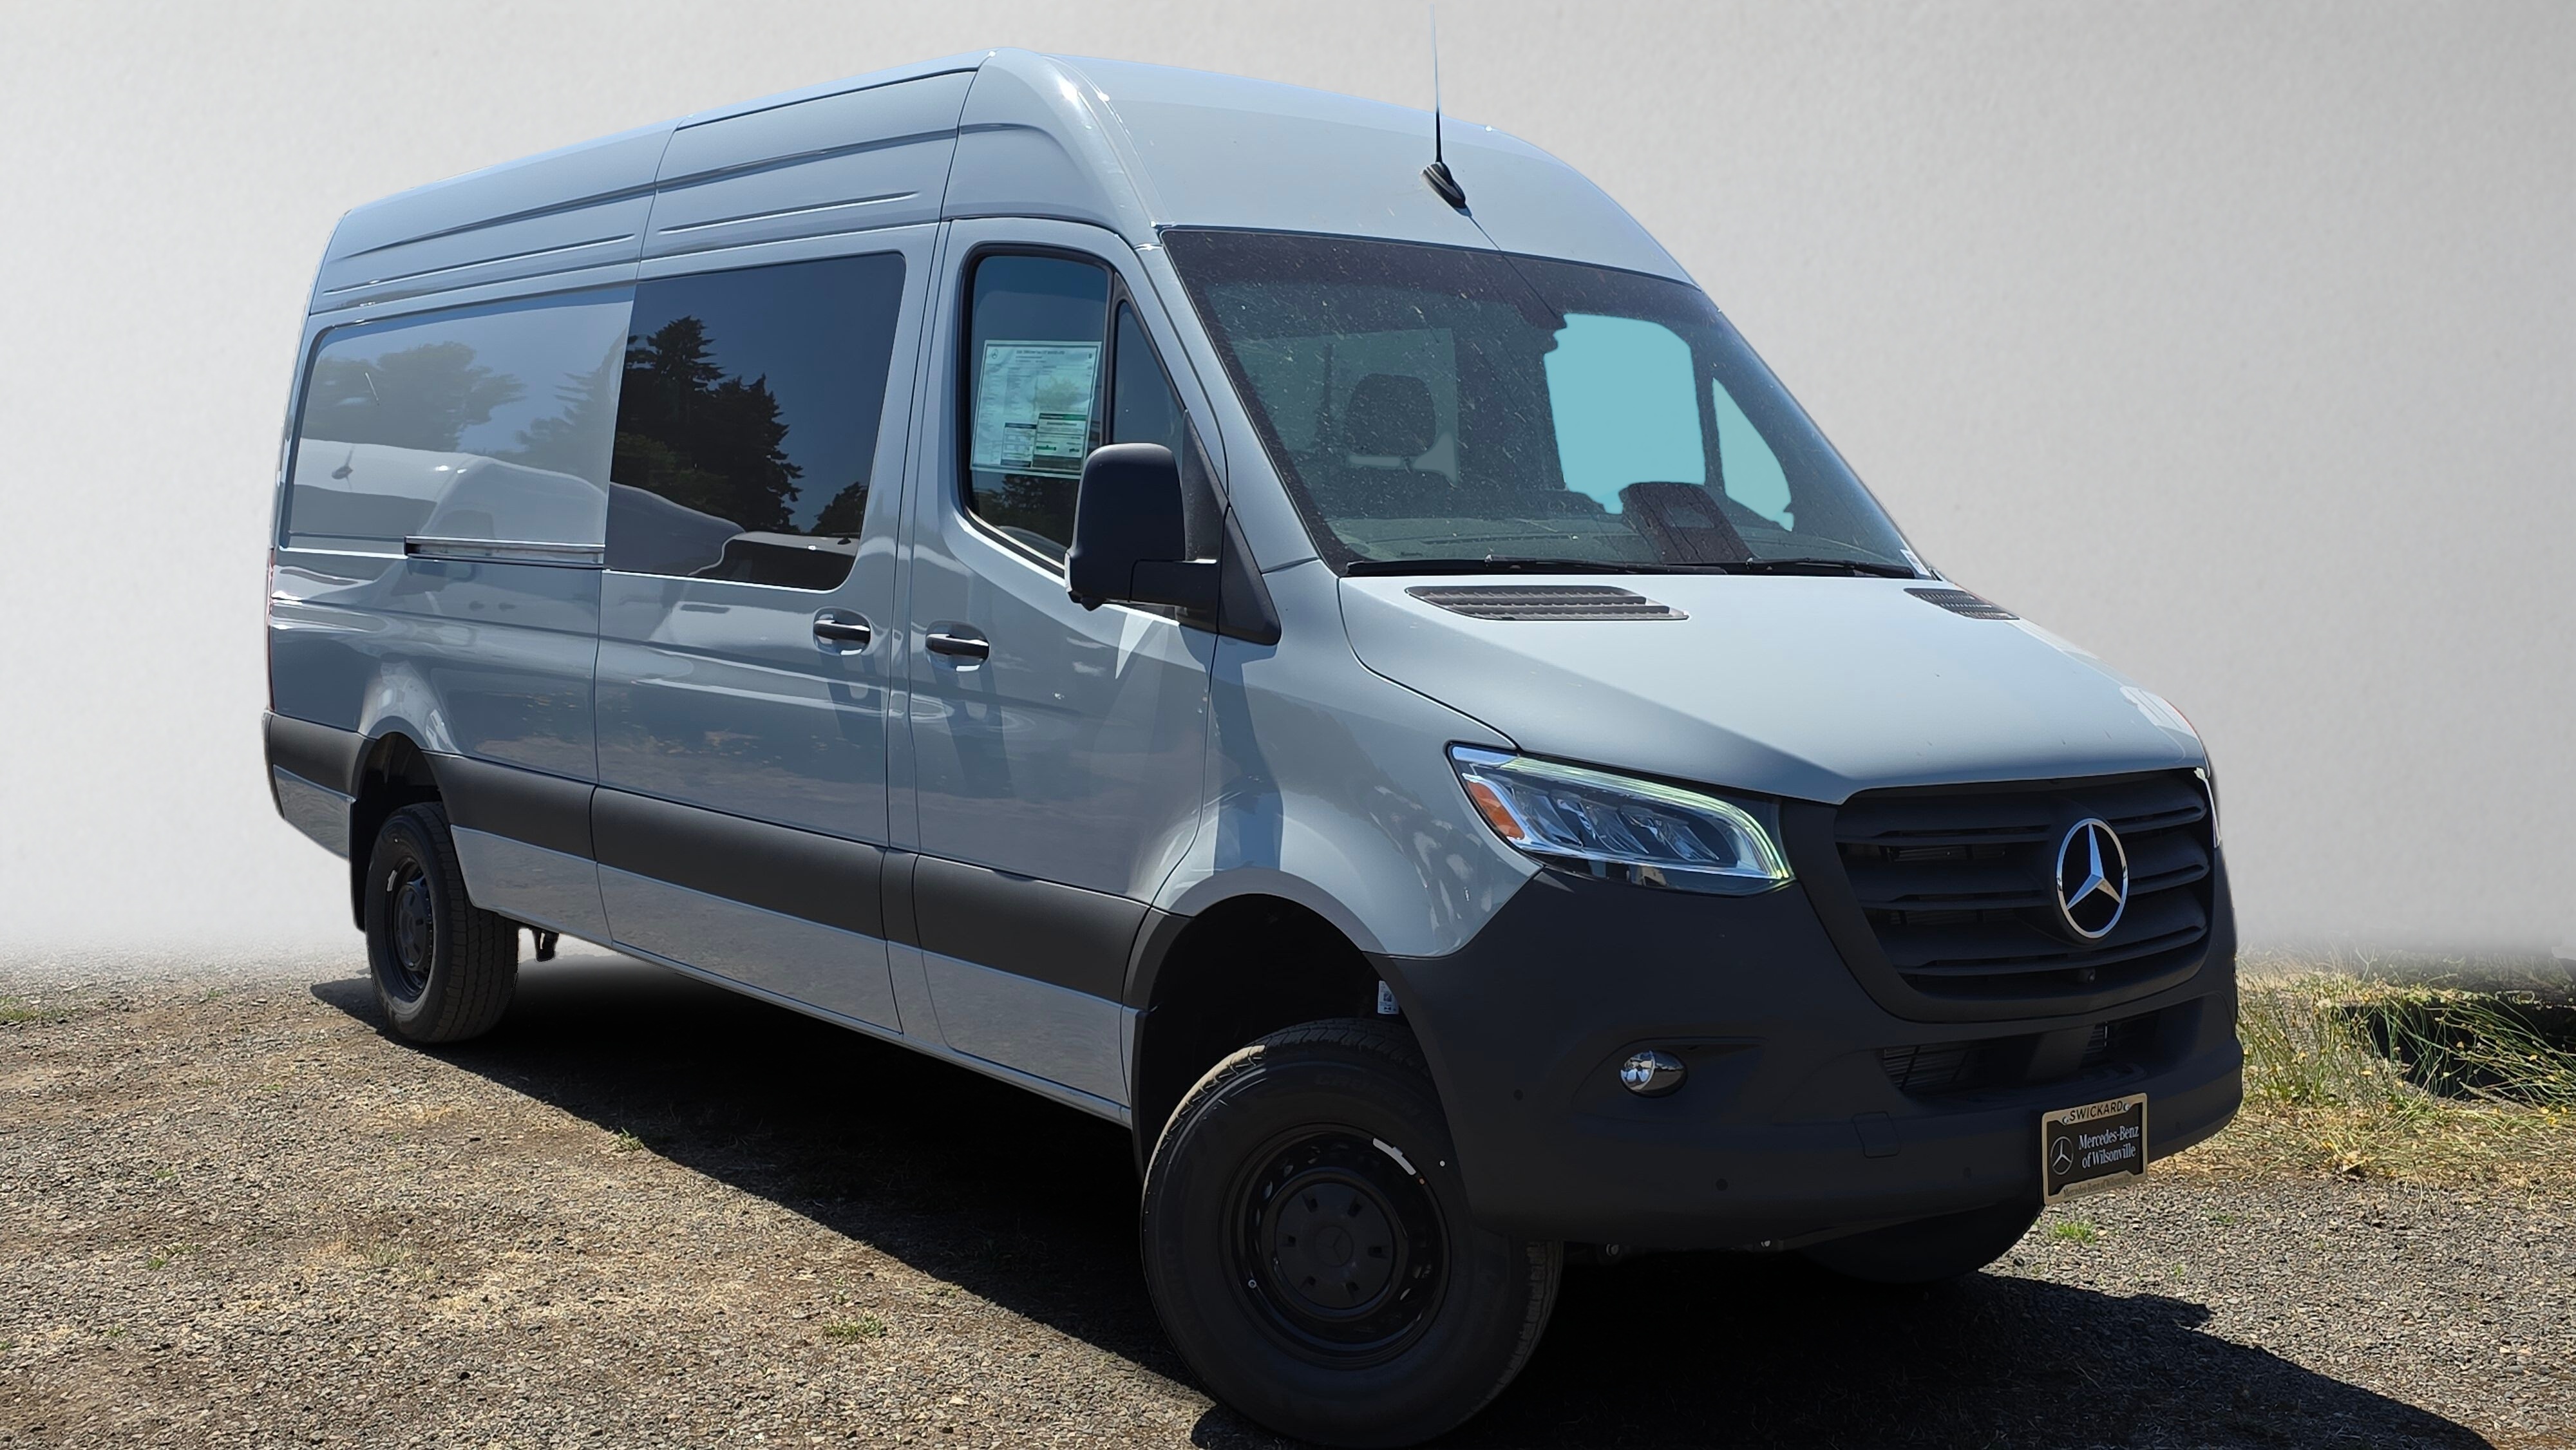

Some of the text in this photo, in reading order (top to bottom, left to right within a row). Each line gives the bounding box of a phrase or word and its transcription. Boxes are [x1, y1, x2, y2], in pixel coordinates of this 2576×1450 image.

[2070, 1100, 2123, 1121] SWICKARD
[2078, 1125, 2139, 1150] Mercedes-Benz
[2081, 1142, 2136, 1169] of Wilsonville
